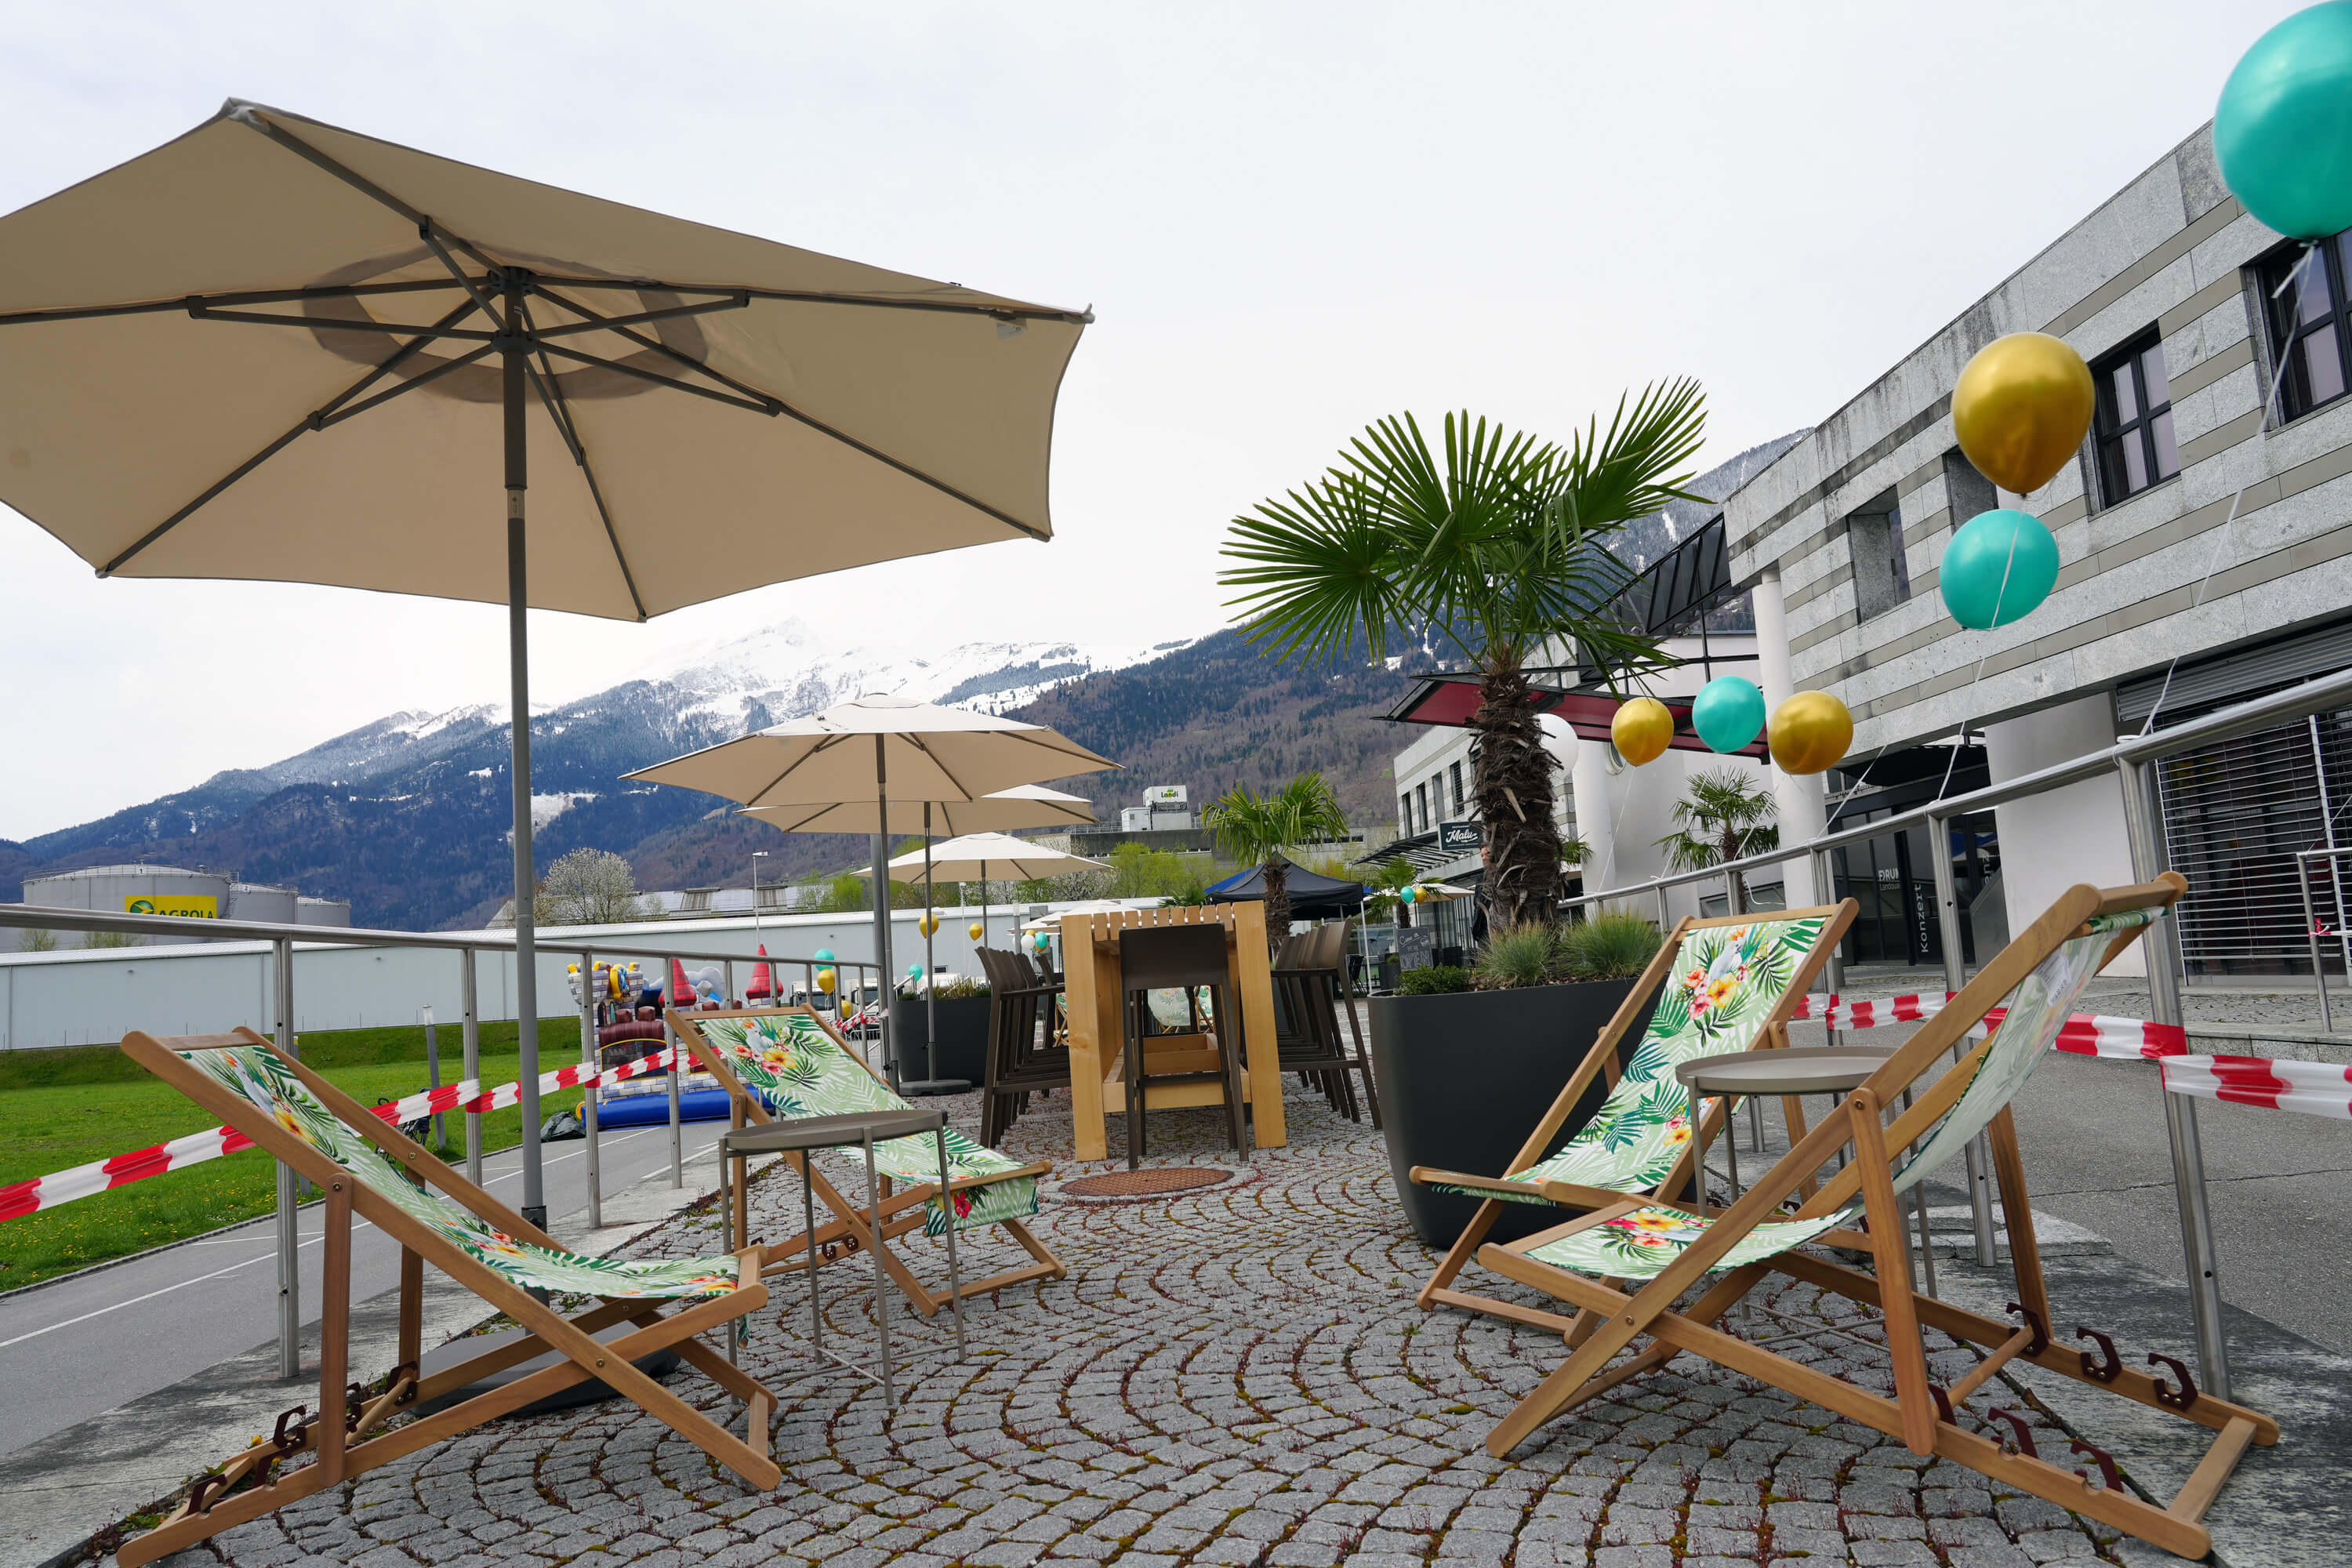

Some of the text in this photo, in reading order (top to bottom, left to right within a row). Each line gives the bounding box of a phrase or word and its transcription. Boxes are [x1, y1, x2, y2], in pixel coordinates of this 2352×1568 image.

[1160, 789, 1179, 798] Landi
[1446, 829, 1478, 843] Malu
[1915, 884, 1929, 953] Konzert
[1400, 951, 1430, 968] OPEN
